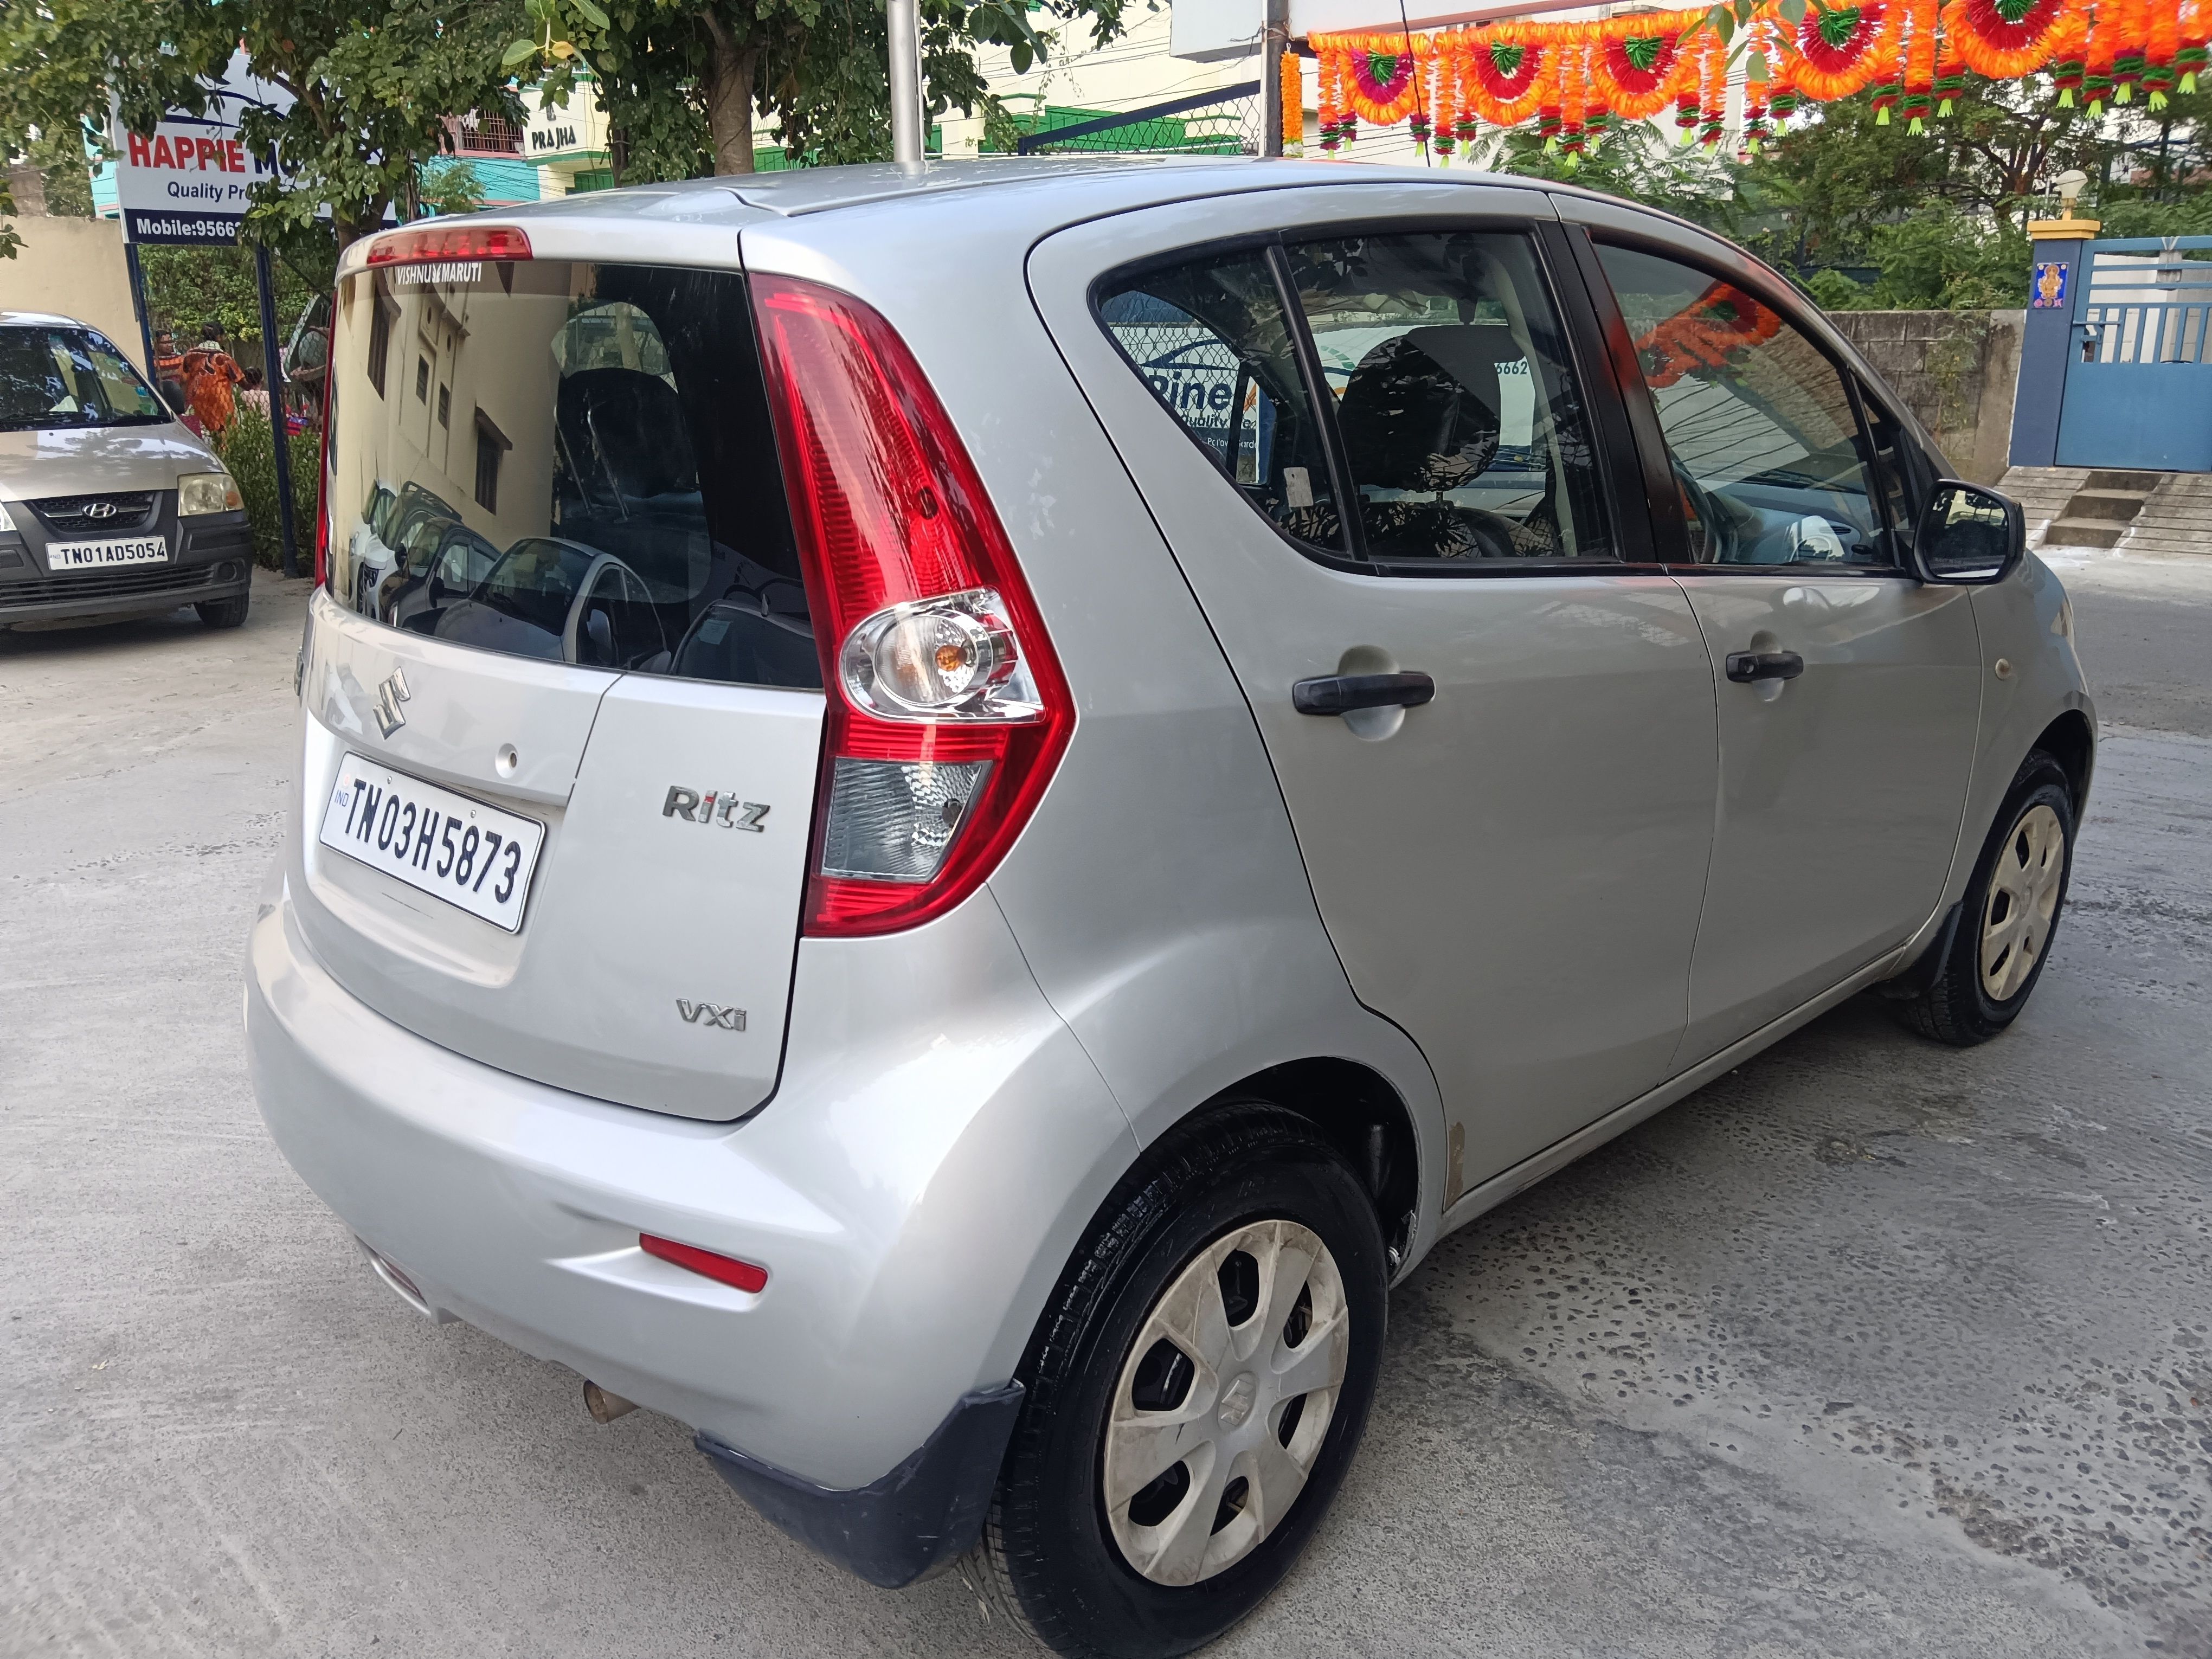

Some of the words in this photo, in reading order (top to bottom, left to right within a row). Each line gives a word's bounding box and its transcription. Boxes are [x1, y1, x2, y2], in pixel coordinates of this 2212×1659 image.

[127, 133, 246, 173] HAPPIE
[168, 182, 223, 202] Quality
[137, 218, 241, 237] Mobile:9566
[397, 265, 432, 285] VISHNU
[441, 262, 482, 282] MARUTI
[61, 542, 165, 564] TN01AD5054
[335, 789, 349, 807] IND
[345, 778, 521, 903] TN03H5873
